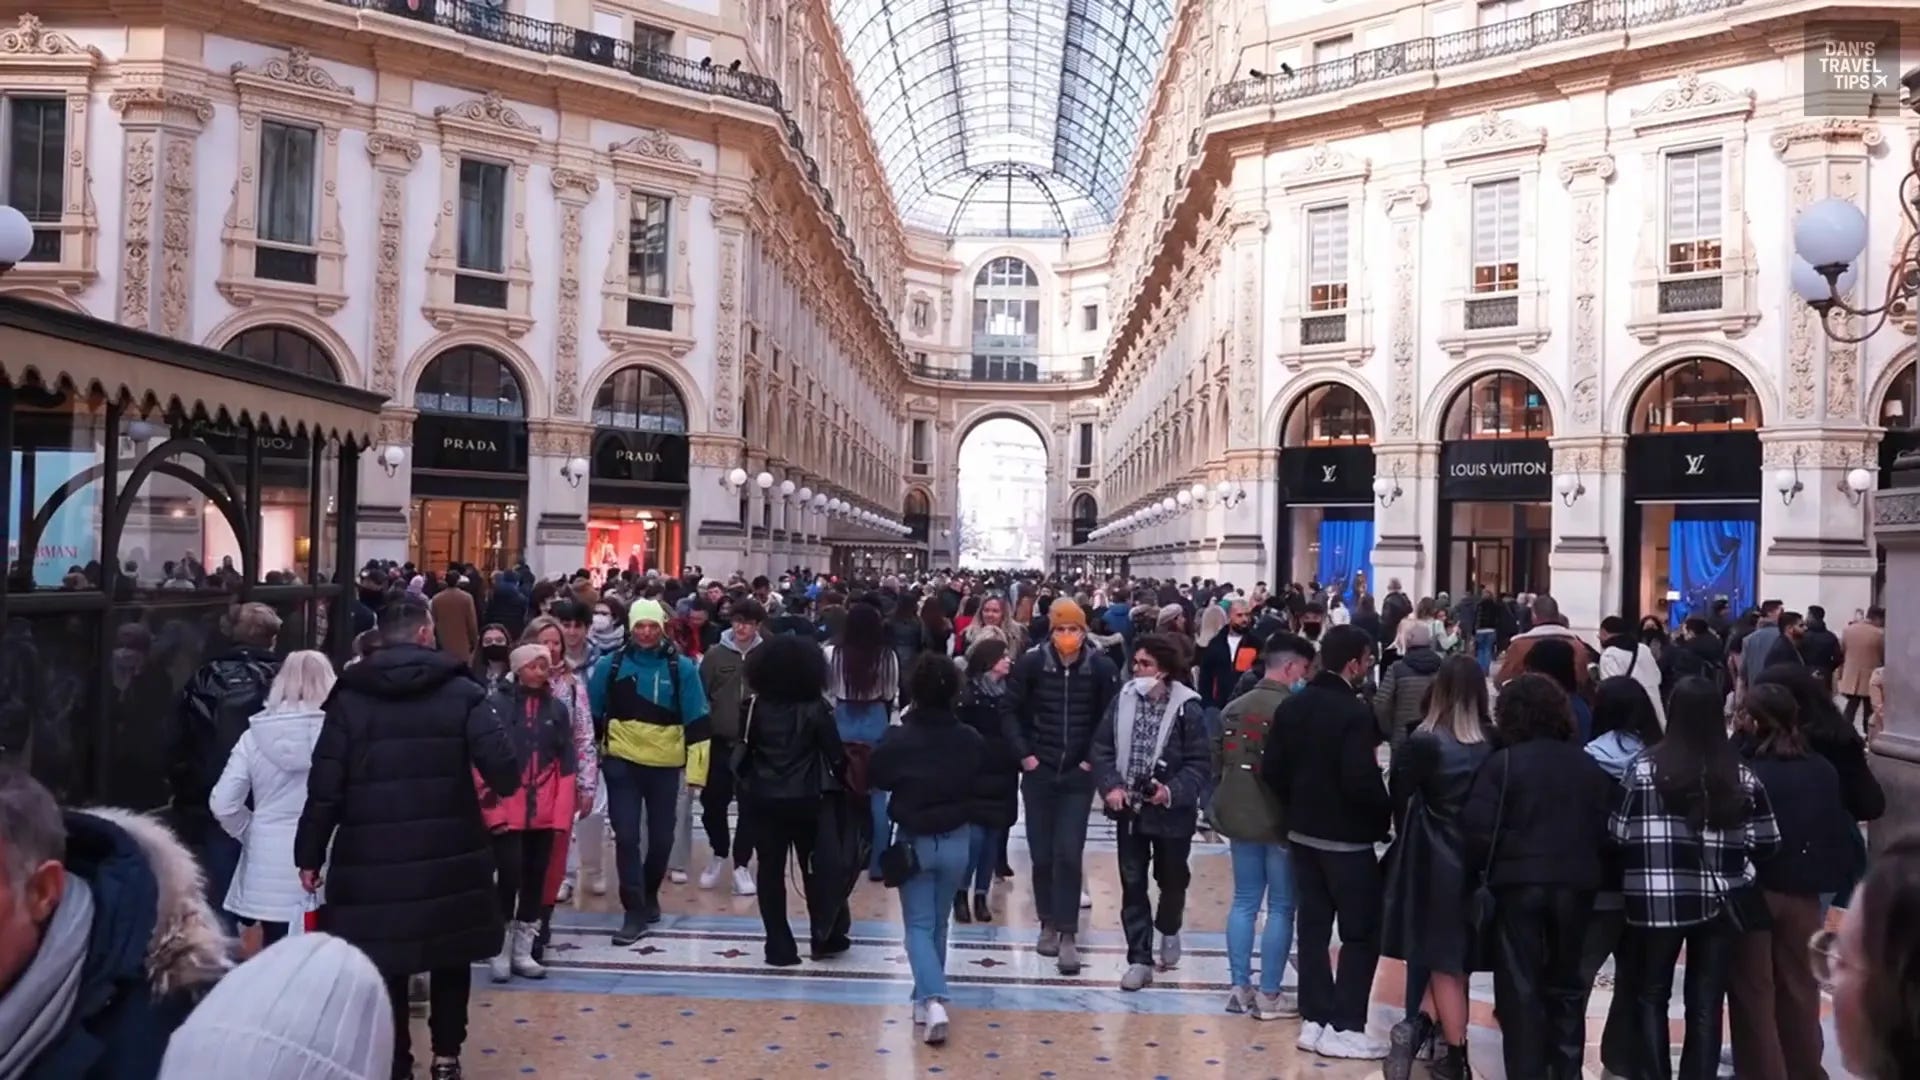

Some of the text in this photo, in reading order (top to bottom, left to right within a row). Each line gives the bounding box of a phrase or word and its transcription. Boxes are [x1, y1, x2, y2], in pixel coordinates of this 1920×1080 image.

[443, 437, 497, 452] PRADA
[615, 449, 663, 463] PRADA
[1450, 462, 1546, 477] LOUIS VUITTON
